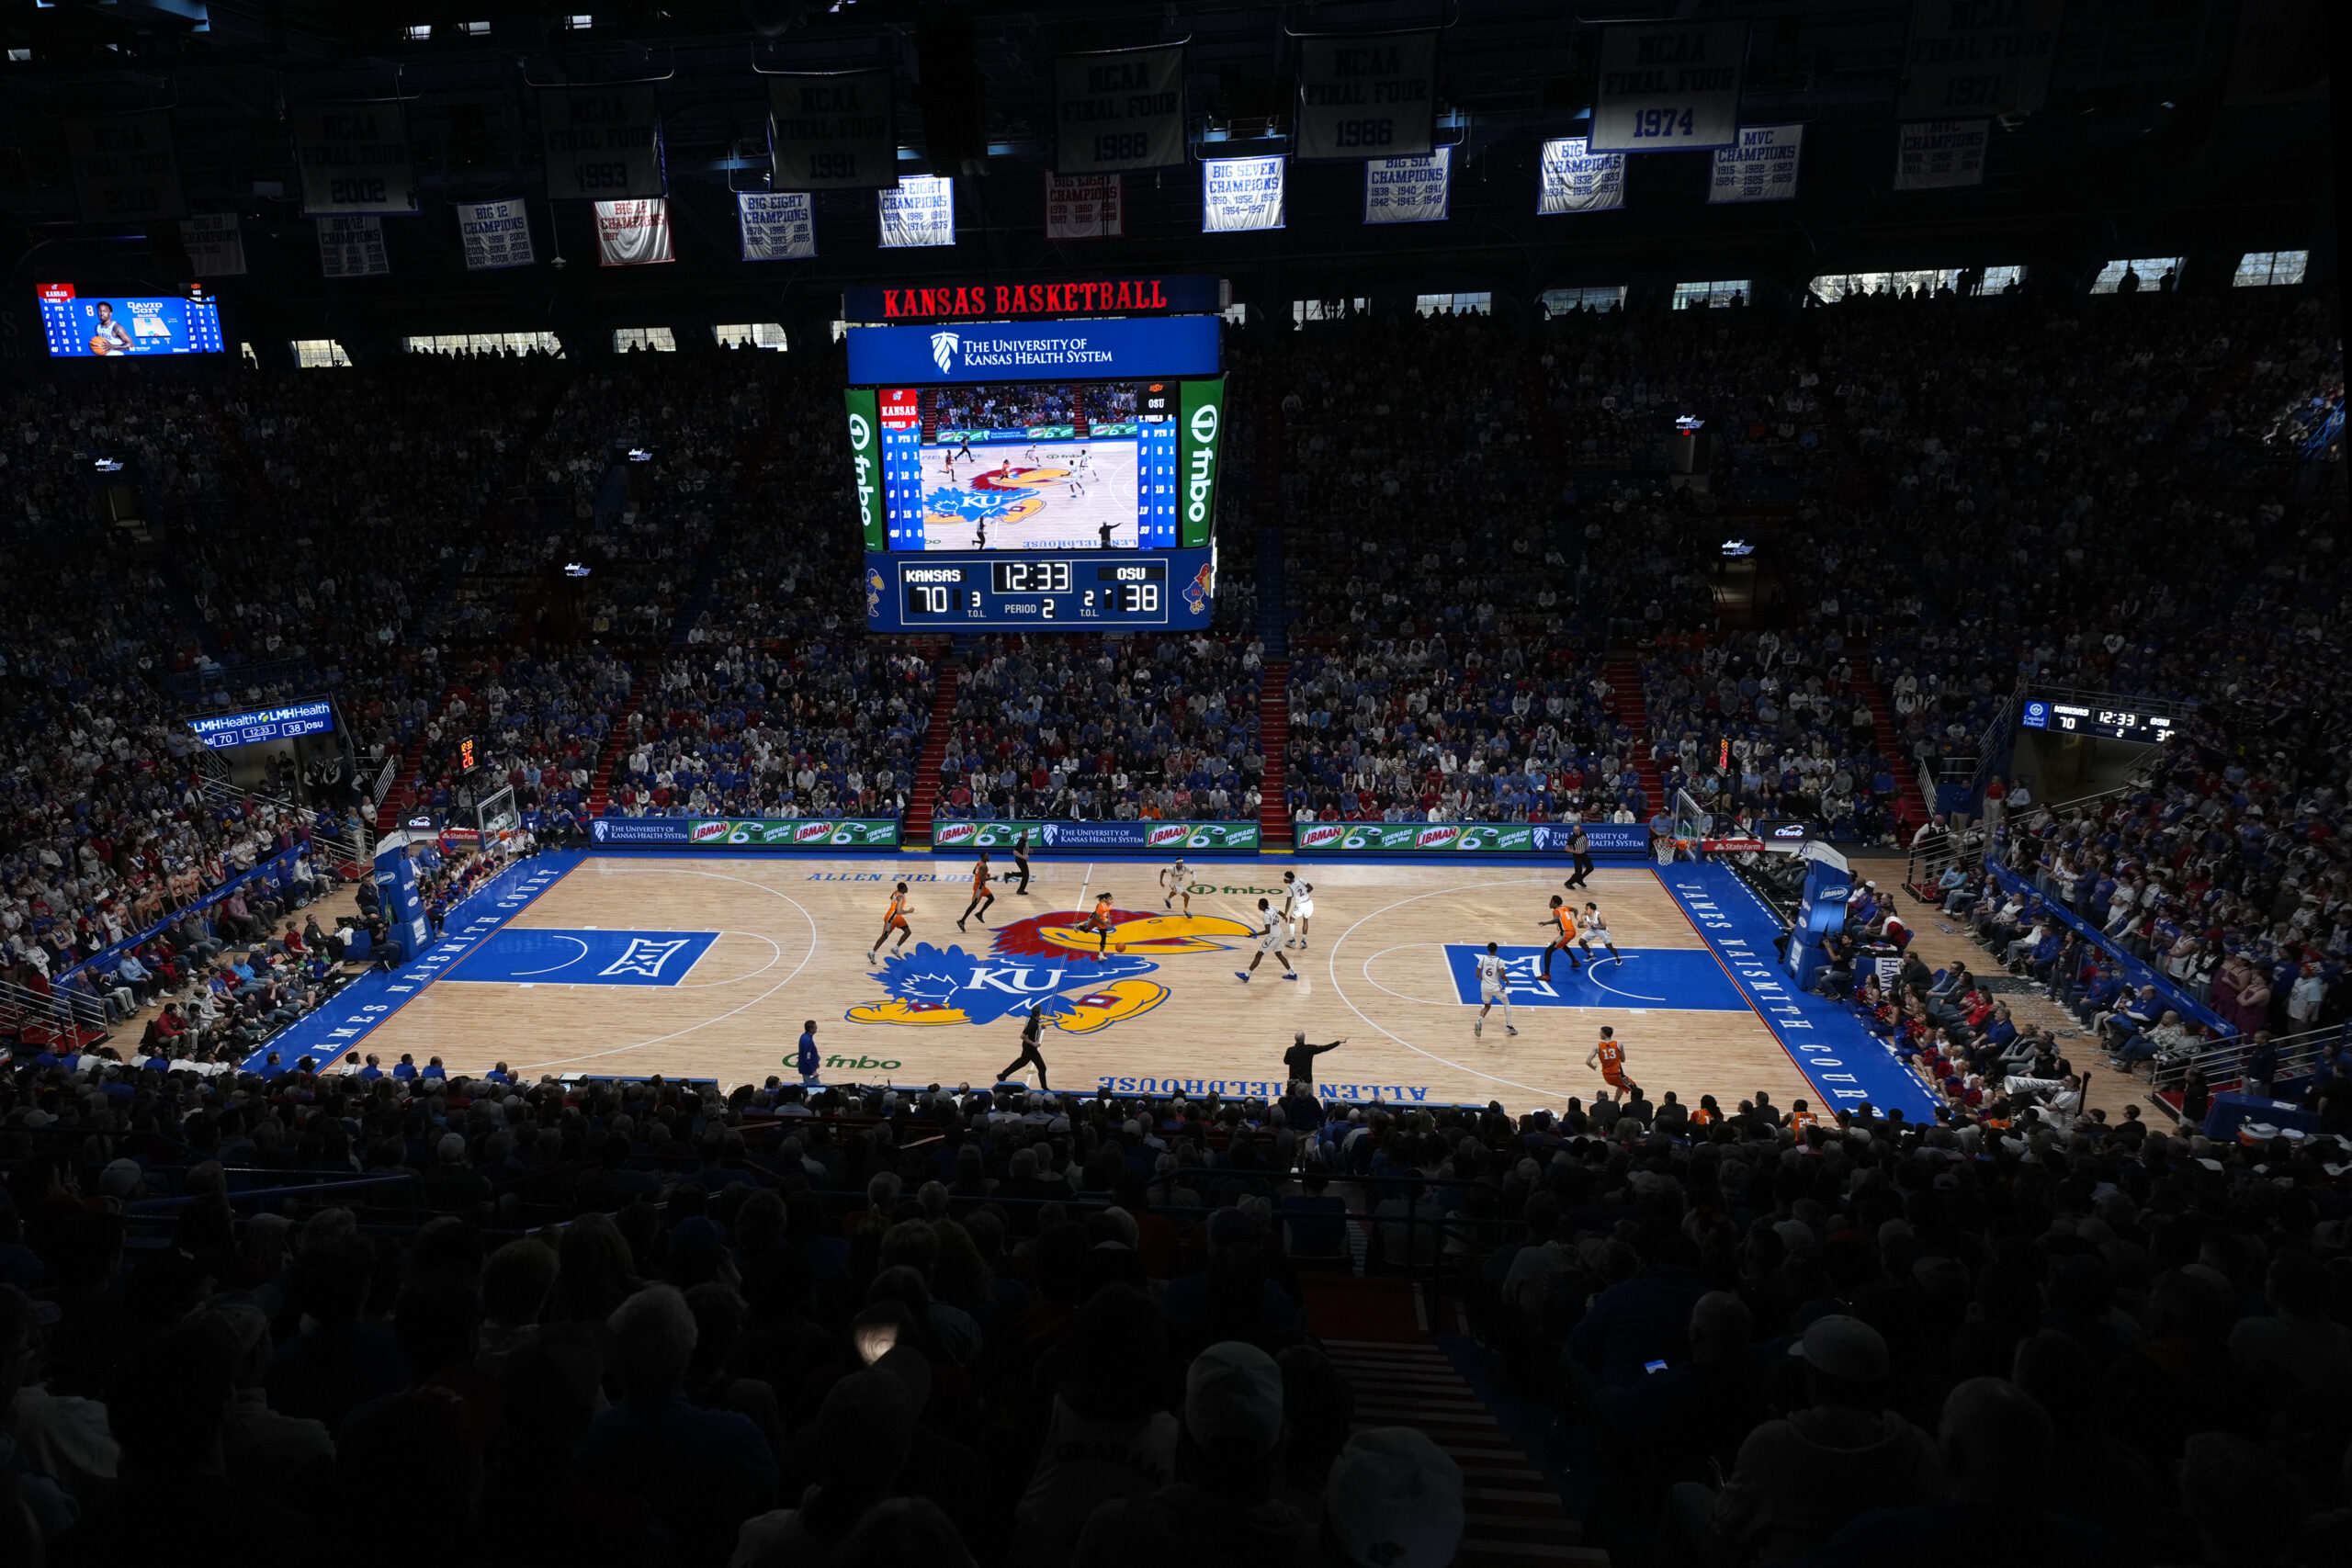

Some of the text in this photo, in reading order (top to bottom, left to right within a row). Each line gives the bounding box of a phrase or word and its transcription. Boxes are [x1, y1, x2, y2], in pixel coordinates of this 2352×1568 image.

[1638, 34, 1706, 64] NCAA
[1335, 47, 1397, 76] NCAA
[1087, 62, 1149, 93] NCAA
[1604, 67, 1733, 96] FINAL FOUR
[1307, 79, 1427, 106] FINAL FOUR
[1062, 92, 1177, 122] FINAL FOUR
[1634, 107, 1693, 138] 1974
[1336, 118, 1393, 148] 1986
[1744, 130, 1774, 146] MVC
[1093, 132, 1148, 162] 1988
[1561, 144, 1583, 158] BIG
[1717, 145, 1796, 164] CHAMPIONS
[809, 152, 855, 179] 1991
[1213, 162, 1276, 178] BIG SEVEN
[1545, 155, 1622, 174] CHAMPIONS
[1717, 163, 1792, 175] 1915 1922 1923
[580, 163, 627, 191] 1993
[1371, 167, 1443, 185] CHAMPIONS
[1714, 176, 1735, 186] 1924
[330, 178, 387, 203] 2002
[910, 181, 942, 194] EIGHT
[1209, 177, 1279, 194] CHAMPIONS
[1371, 185, 1442, 196] 1938 1940 1941
[1743, 186, 1763, 196] 1927
[615, 203, 634, 215] BIG
[747, 195, 803, 209] BIG EIGHT
[882, 195, 947, 210] CHAMPIONS
[1370, 197, 1389, 207] 1942
[1396, 197, 1416, 206] 1943
[476, 205, 507, 220] BIG 12
[744, 209, 808, 224] CHAMPIONS
[463, 217, 524, 234] CHAMPIONS
[600, 214, 664, 230] CHAMPIONS
[883, 280, 1168, 318] KANSAS BASKETBALL
[85, 305, 95, 317] 8
[963, 337, 1088, 354] THE UNIVERSITY OF
[964, 349, 1113, 367] KANSAS HEALTH SYSTEM
[881, 406, 916, 416] KANSAS
[1148, 399, 1165, 408] OSU
[854, 454, 875, 526] fnbo
[1188, 447, 1213, 522] fnbo
[960, 496, 1001, 507] KU
[906, 569, 961, 582] KANSAS
[1005, 563, 1069, 591] 12:33
[1117, 567, 1147, 581] OSU
[916, 586, 981, 613] 70 3
[1084, 584, 1158, 612] 2 38
[1004, 599, 1054, 618] PERIOD 2
[2053, 705, 2170, 727] KANSAS 12:33 OSU
[250, 721, 323, 736] 12:33 38 OSU
[2059, 716, 2075, 729] 70
[2116, 728, 2124, 738] 2
[220, 734, 232, 744] 70
[462, 750, 474, 769] 26
[408, 818, 431, 828] Club
[763, 825, 791, 838] TORNADO
[691, 823, 728, 841] LIBMAN
[794, 823, 831, 843] LIBMAN
[866, 825, 895, 839] TORNADO
[936, 824, 974, 844] LIBMAN
[1148, 827, 1187, 846] LIBMAN
[1225, 828, 1256, 842] TORNADO
[1300, 827, 1342, 848] LIBMAN
[1381, 829, 1413, 842] TORNADO
[1415, 827, 1458, 849] LIBMAN
[1498, 829, 1530, 843] TORNADO
[1553, 831, 1568, 840] THE
[1774, 827, 1804, 837] Club
[808, 873, 1037, 883] ALLEN FIELDHUSE
[1221, 886, 1283, 895] fnbo
[1297, 888, 1305, 897] 2
[1819, 888, 1848, 900] LIBMAN
[386, 916, 501, 993] NAISMITH
[497, 869, 559, 908] COURT
[1677, 884, 1733, 929] JAMES
[1718, 939, 1814, 1030] NAISMITH
[1486, 967, 1493, 976] 6
[963, 967, 1069, 994] KU
[825, 1055, 901, 1069] fnbo
[1602, 1048, 1616, 1060] 13
[1098, 1076, 1430, 1100] IELDHOUSE ALLEN
